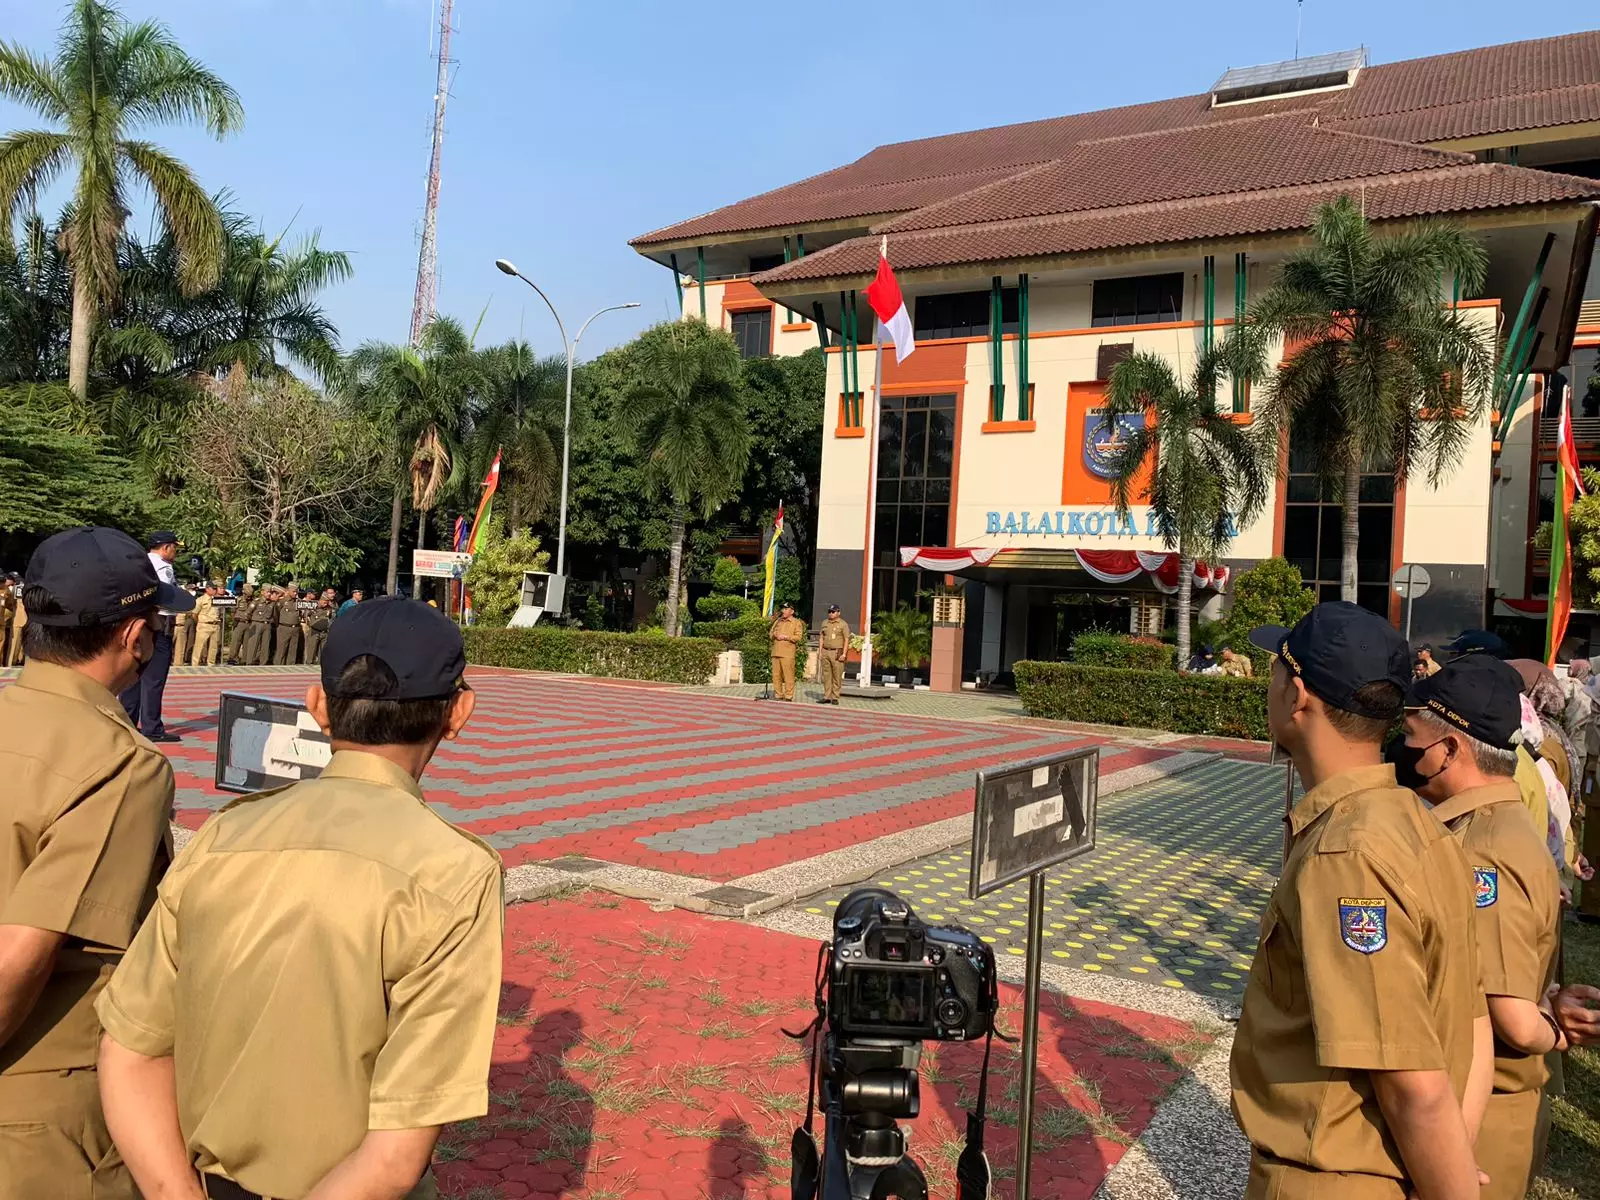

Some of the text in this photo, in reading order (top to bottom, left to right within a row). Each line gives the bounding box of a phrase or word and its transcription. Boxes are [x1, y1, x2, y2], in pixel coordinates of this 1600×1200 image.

[121, 593, 142, 606] KOTA
[1284, 651, 1303, 675] DEPOK
[1427, 699, 1470, 728] KOTA DEPOK
